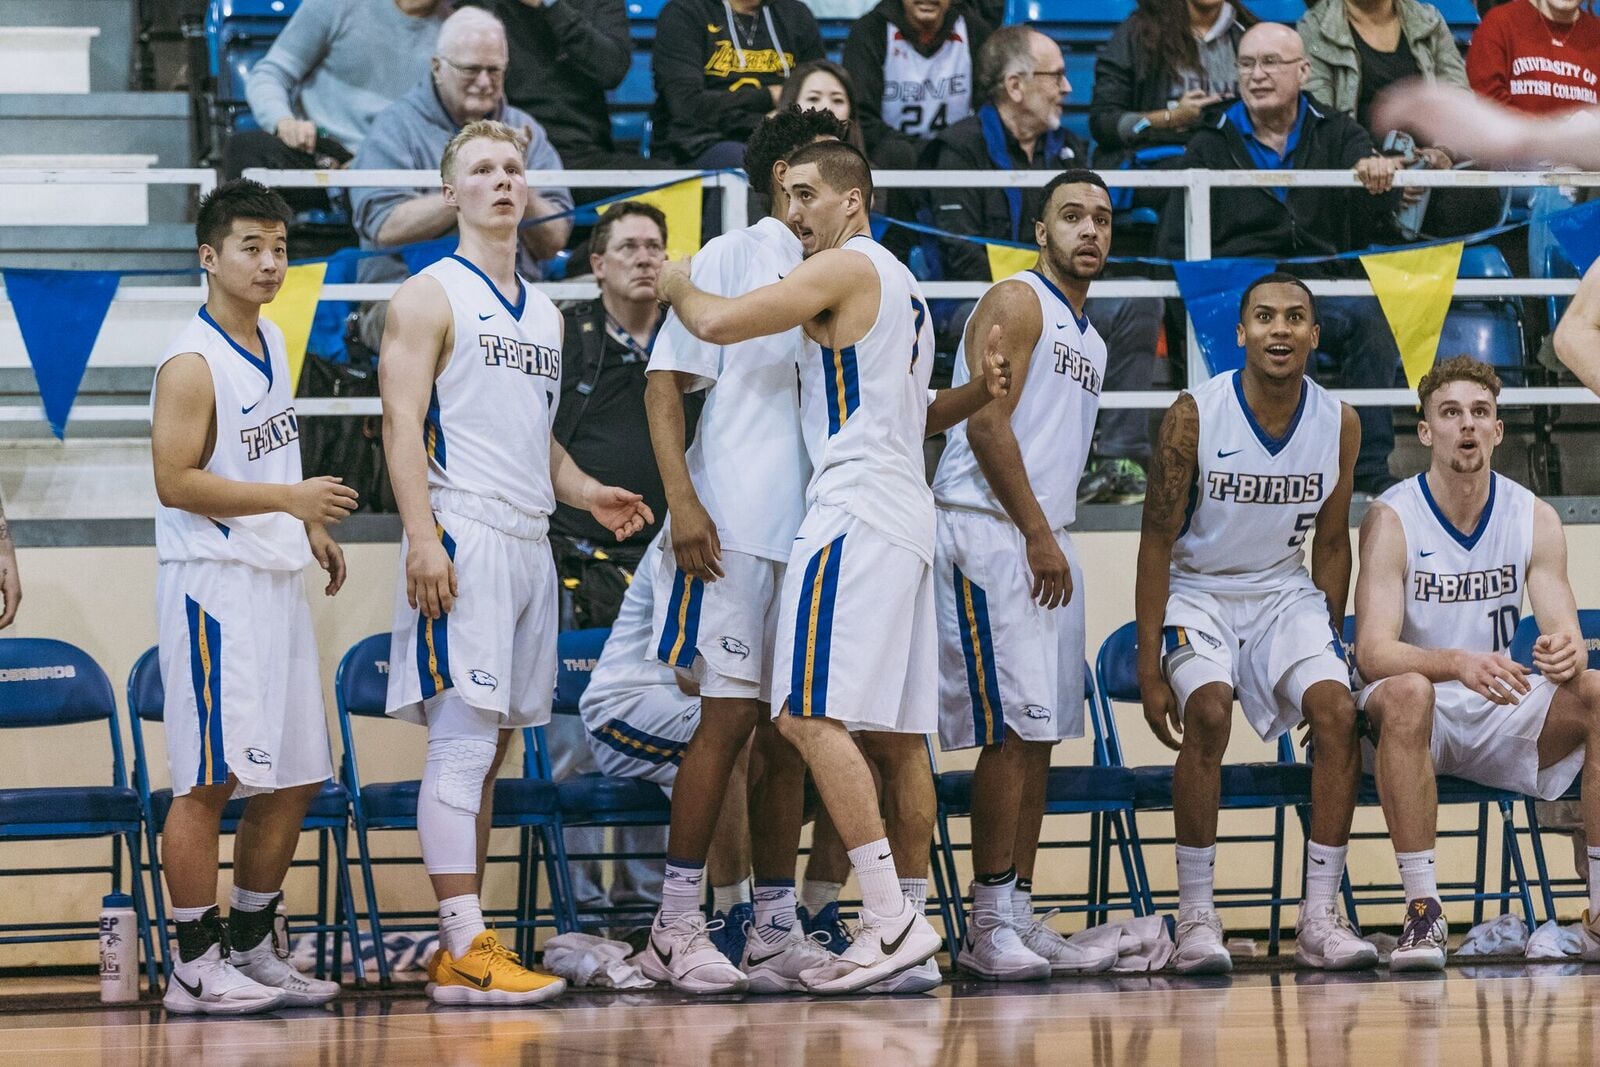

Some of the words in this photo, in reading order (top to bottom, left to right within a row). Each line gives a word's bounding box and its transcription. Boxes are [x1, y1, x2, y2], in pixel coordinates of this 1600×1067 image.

[1512, 56, 1581, 77] UNIVERSITY
[1582, 68, 1598, 86] OF
[1510, 79, 1552, 97] BRITISH
[1552, 82, 1598, 105] COLUMBIA
[901, 102, 948, 137] 24
[1207, 470, 1323, 505] T-BIRDS
[1287, 513, 1317, 548] 5
[1414, 564, 1518, 604] T-BIRDS
[1487, 604, 1520, 653] 10
